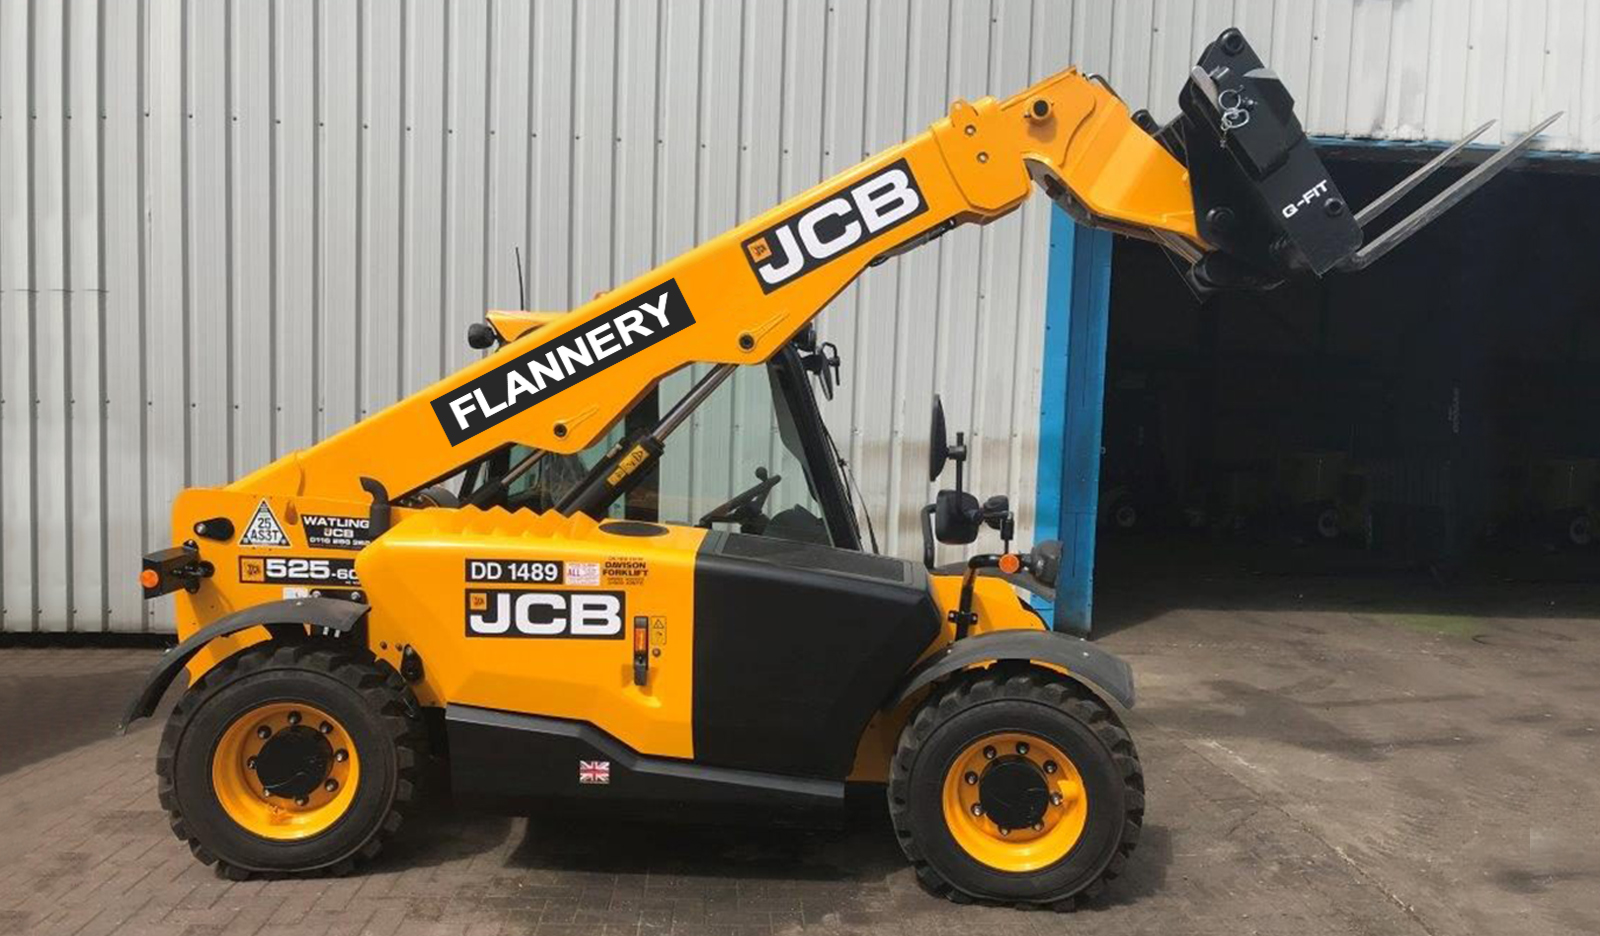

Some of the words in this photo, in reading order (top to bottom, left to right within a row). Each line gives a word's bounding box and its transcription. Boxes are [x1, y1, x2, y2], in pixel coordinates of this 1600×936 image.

[1282, 179, 1327, 218] G-FIT
[758, 169, 920, 285] JCB
[449, 292, 671, 431] FLANNERY
[257, 517, 271, 529] 25
[302, 515, 370, 529] WATLING
[323, 527, 354, 538] JCB
[471, 562, 502, 580] DD
[508, 563, 559, 581] 1489
[602, 569, 648, 577] FORKLIFT
[604, 561, 646, 569] DAVISON
[470, 593, 622, 635] JCB
